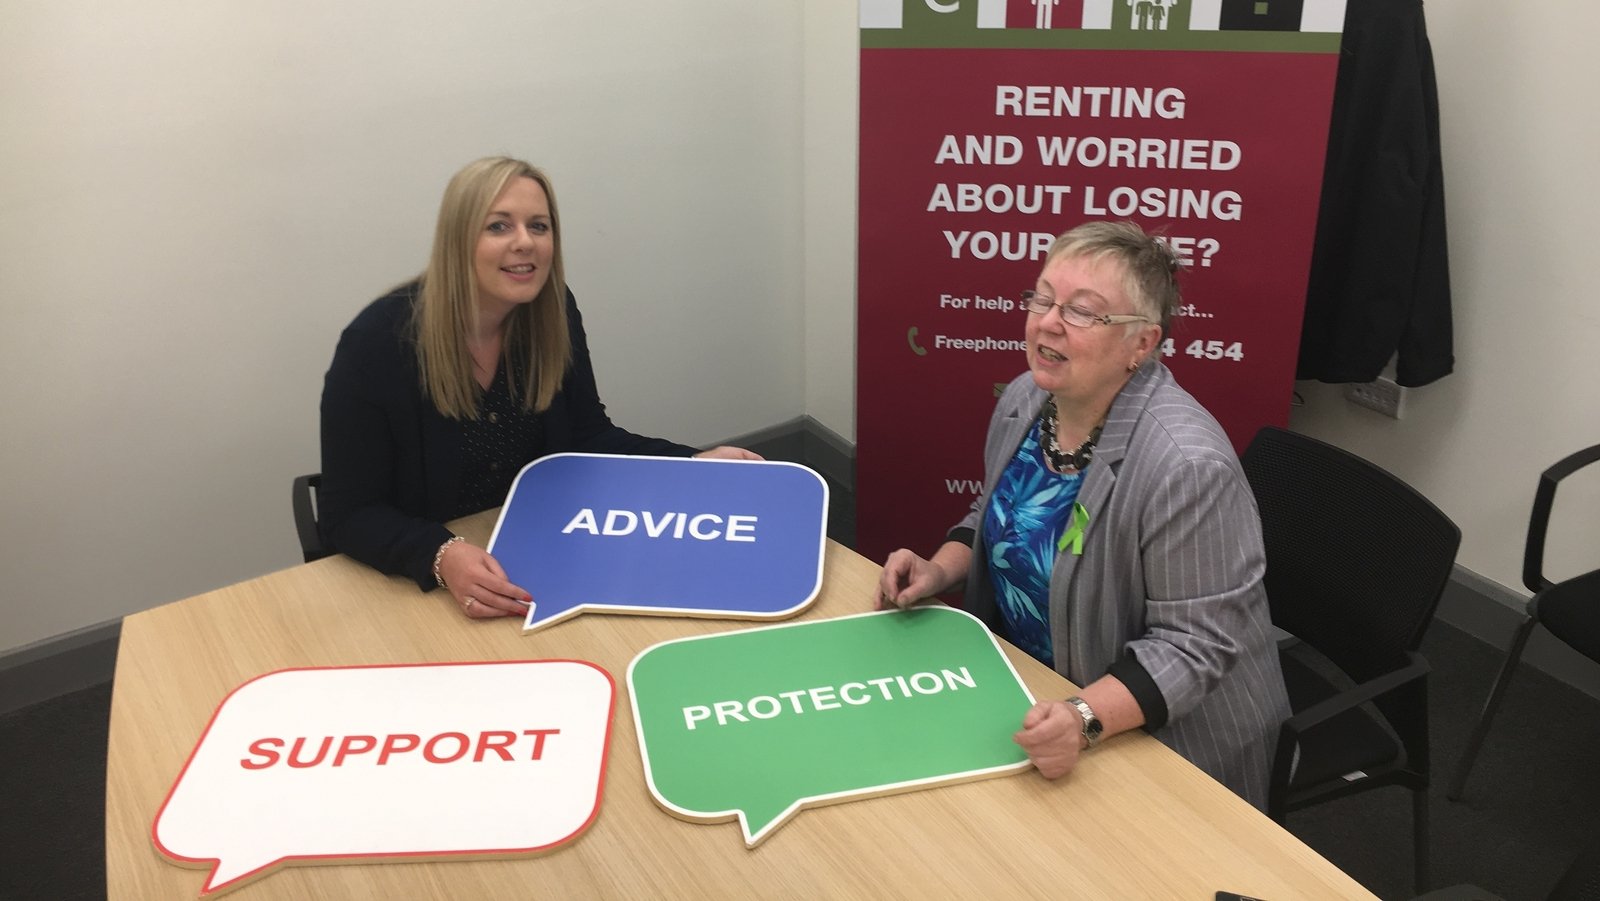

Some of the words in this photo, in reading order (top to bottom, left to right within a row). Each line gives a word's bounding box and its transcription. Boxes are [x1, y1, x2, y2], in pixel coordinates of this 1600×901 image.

[995, 85, 1187, 120] RENTING
[934, 134, 1024, 166] AND
[1036, 135, 1242, 172] WORRIED
[926, 182, 1072, 216] ABOUT
[1083, 186, 1243, 222] LOSING
[942, 229, 1056, 262] YOUR
[940, 294, 971, 309] For
[974, 295, 1015, 314] help
[934, 334, 1027, 353] Freephone
[1185, 339, 1245, 362] 454
[561, 507, 759, 544] ADVICE
[681, 665, 978, 731] PROTECTION
[239, 727, 561, 771] SUPPORT
